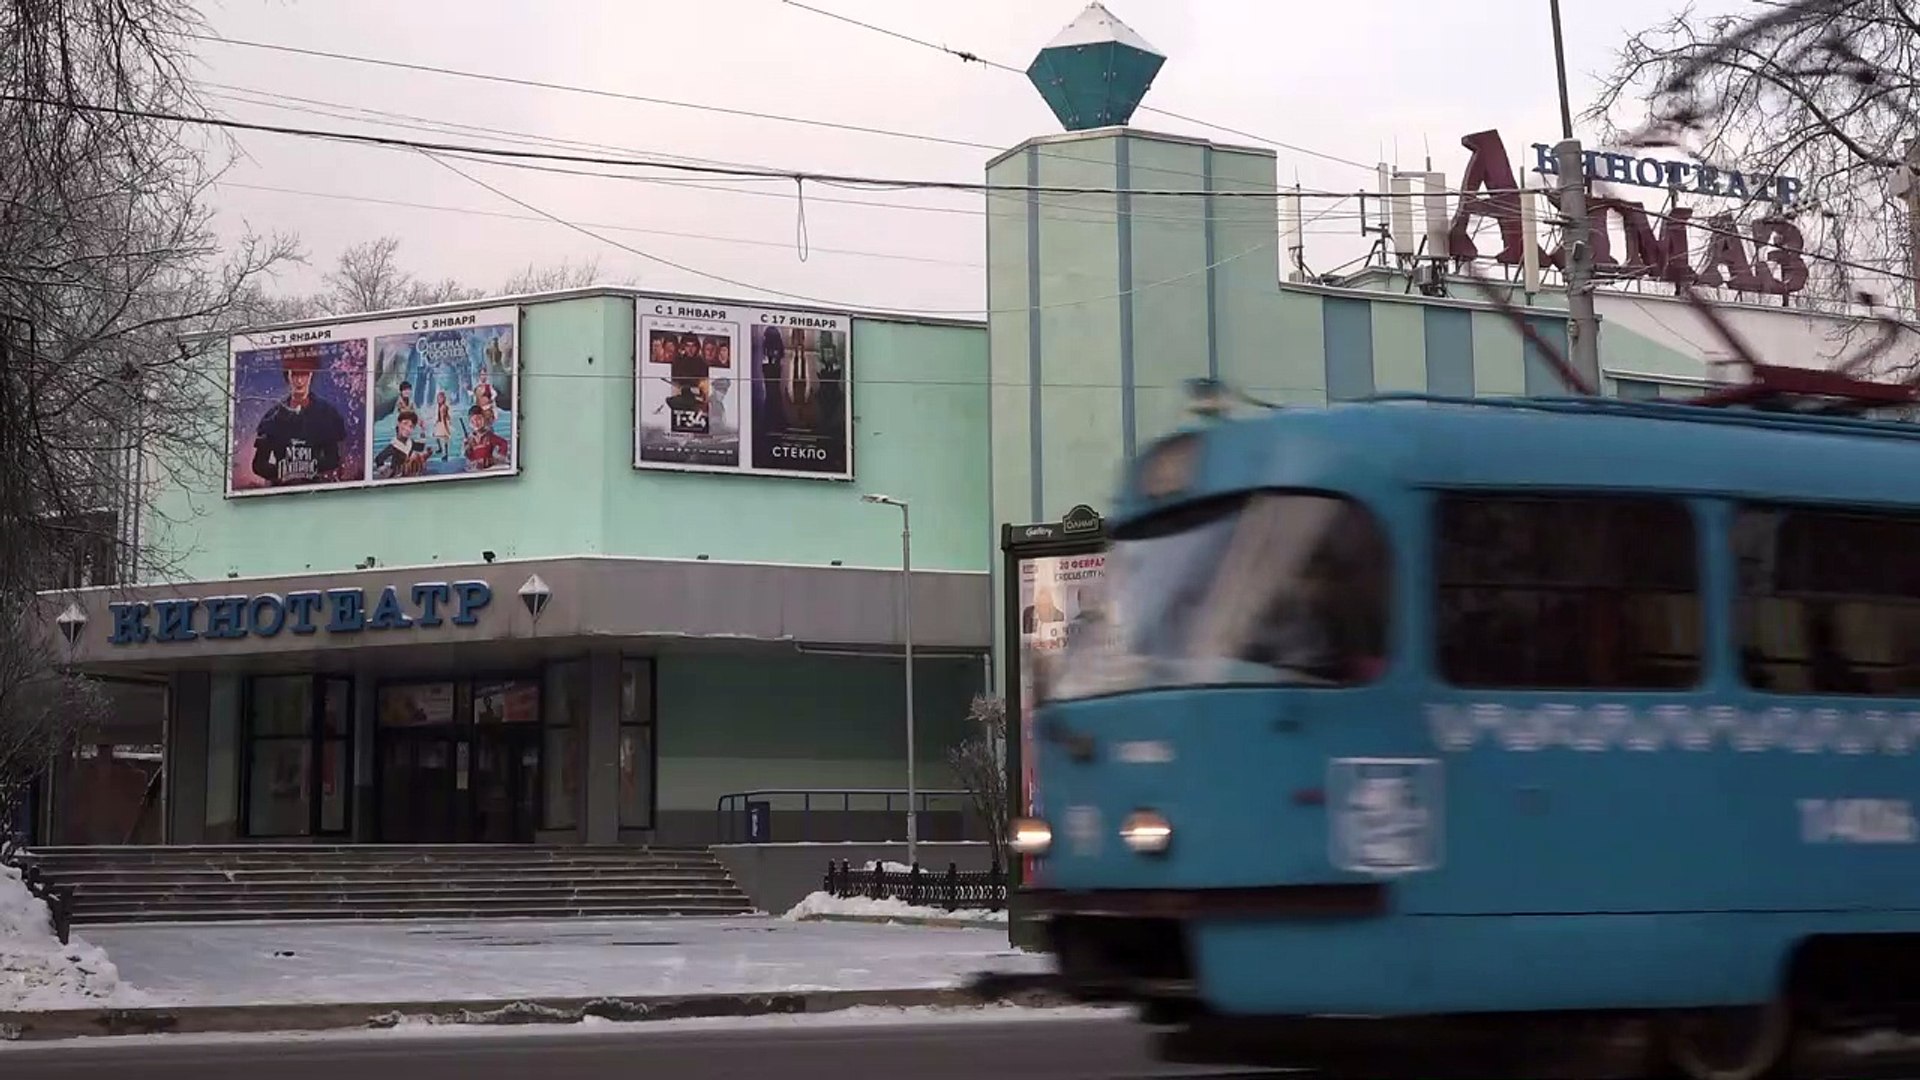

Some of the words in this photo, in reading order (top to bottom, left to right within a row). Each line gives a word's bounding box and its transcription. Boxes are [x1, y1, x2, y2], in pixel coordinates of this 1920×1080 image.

[1531, 143, 1801, 205] КИНОТЕАТР
[667, 306, 673, 315] 1
[678, 308, 726, 320] ЯНВАРЯ
[422, 320, 428, 329] 3
[432, 315, 476, 328] ЯНВАРЯ
[772, 315, 785, 325] 17
[790, 317, 836, 329] ЯНВАРЯ
[281, 334, 286, 343] 3
[290, 330, 331, 342] ЯНВАРЯ
[674, 409, 707, 428] Т-34
[772, 446, 827, 460] СТЕКЛО
[1025, 526, 1053, 538] Gallery
[1058, 560, 1070, 570] 20
[107, 579, 493, 644] КИНОТЕАТР
